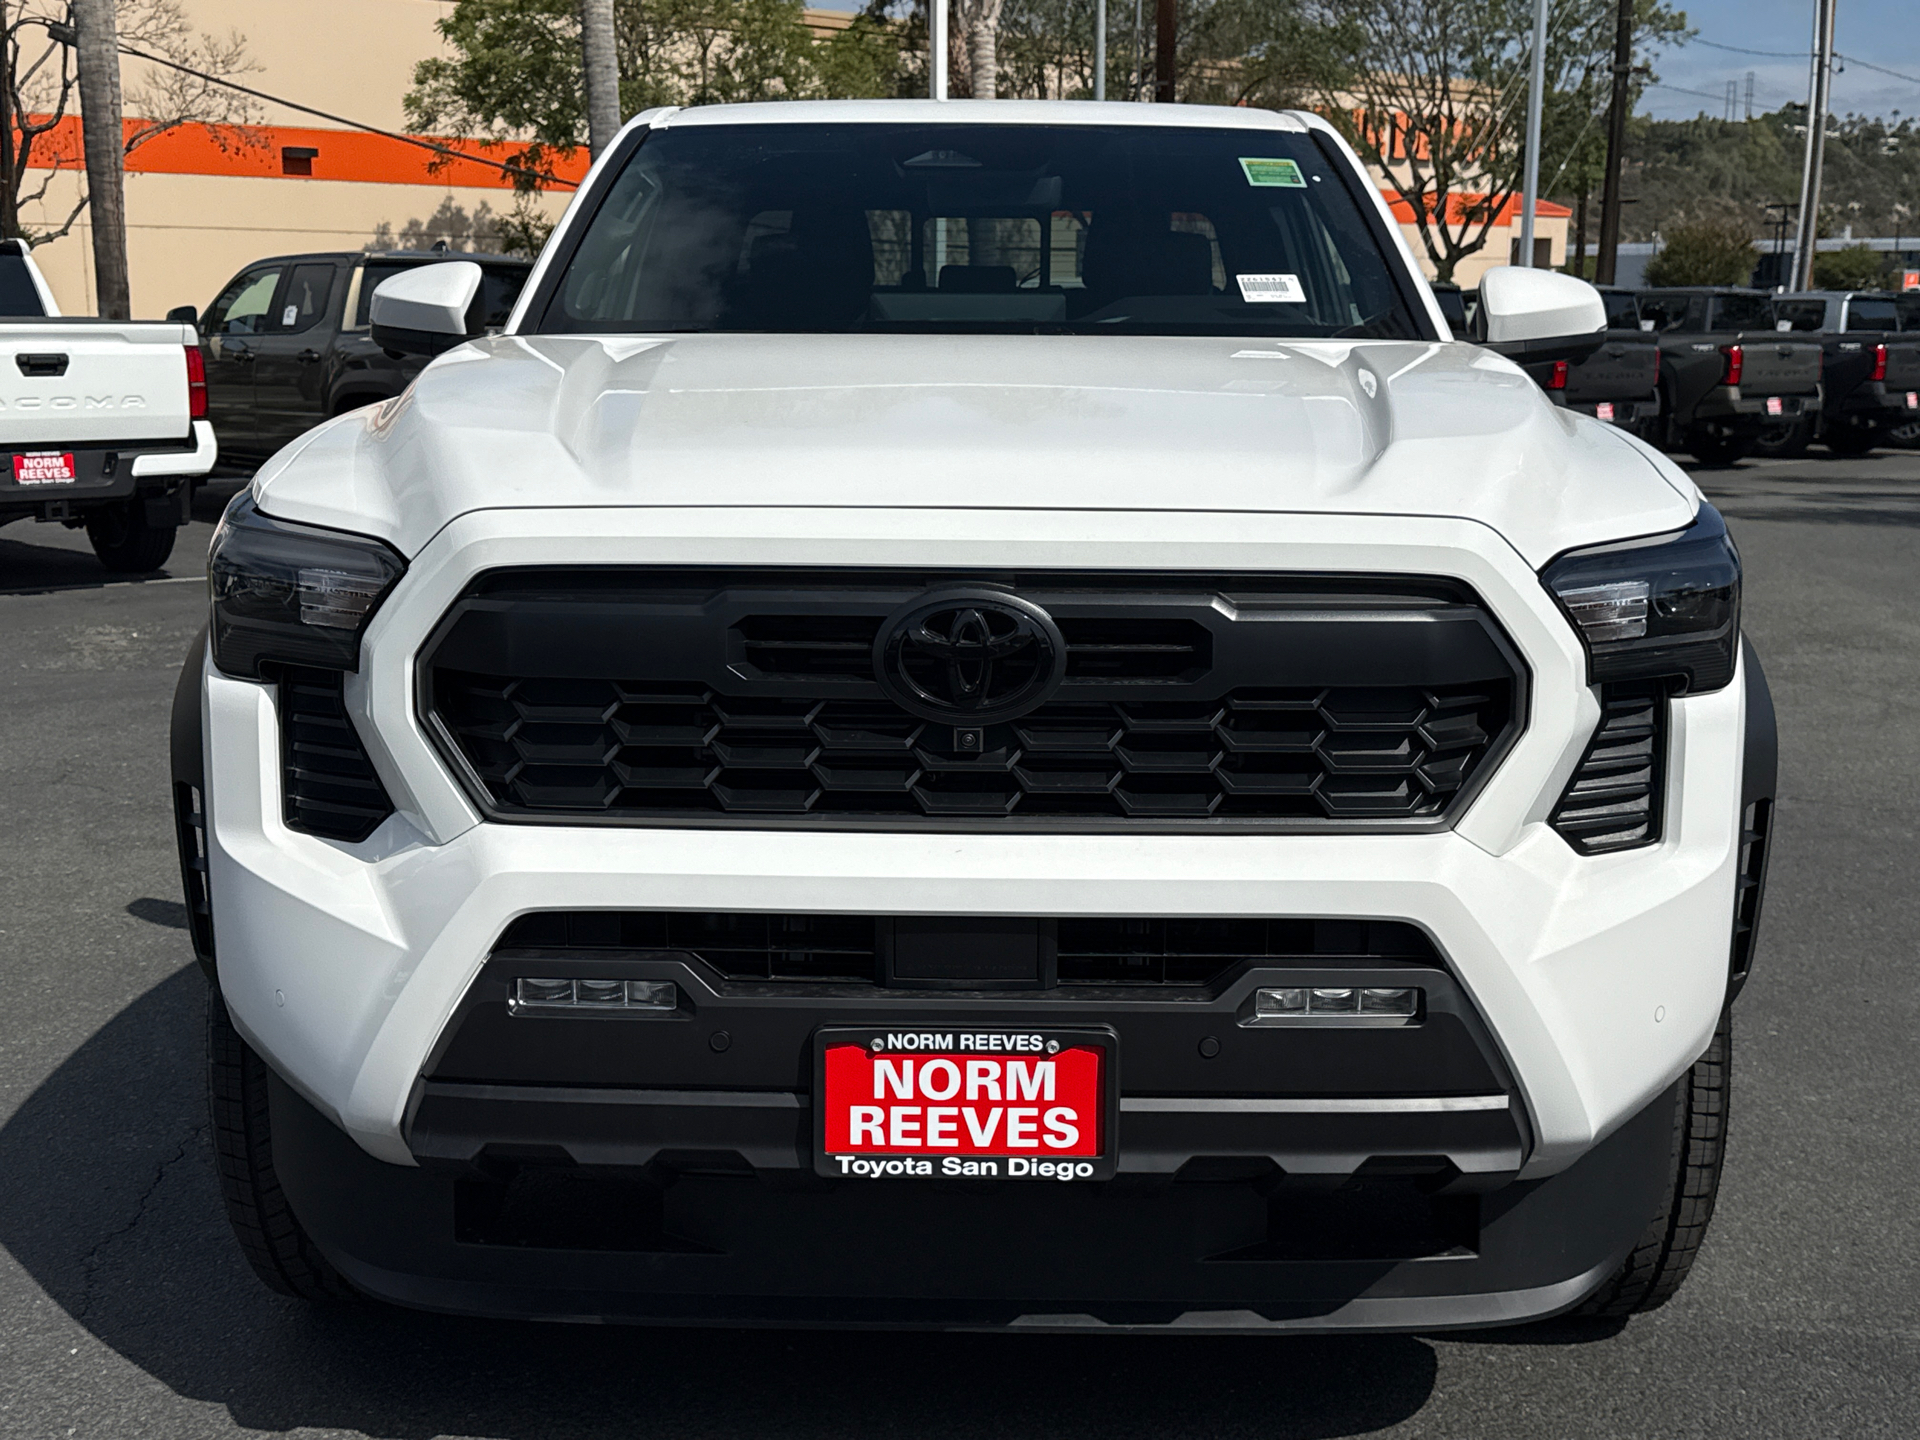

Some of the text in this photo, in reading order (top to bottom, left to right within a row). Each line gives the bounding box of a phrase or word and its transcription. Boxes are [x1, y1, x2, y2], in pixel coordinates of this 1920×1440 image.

[0, 395, 146, 410] COMA
[23, 457, 65, 469] NORM
[19, 467, 71, 480] REEVES
[887, 1033, 1043, 1051] NORM REEVES
[873, 1059, 1056, 1101] NORM
[849, 1105, 1080, 1148] REEVES
[834, 1155, 1094, 1181] Toyota San Diego
